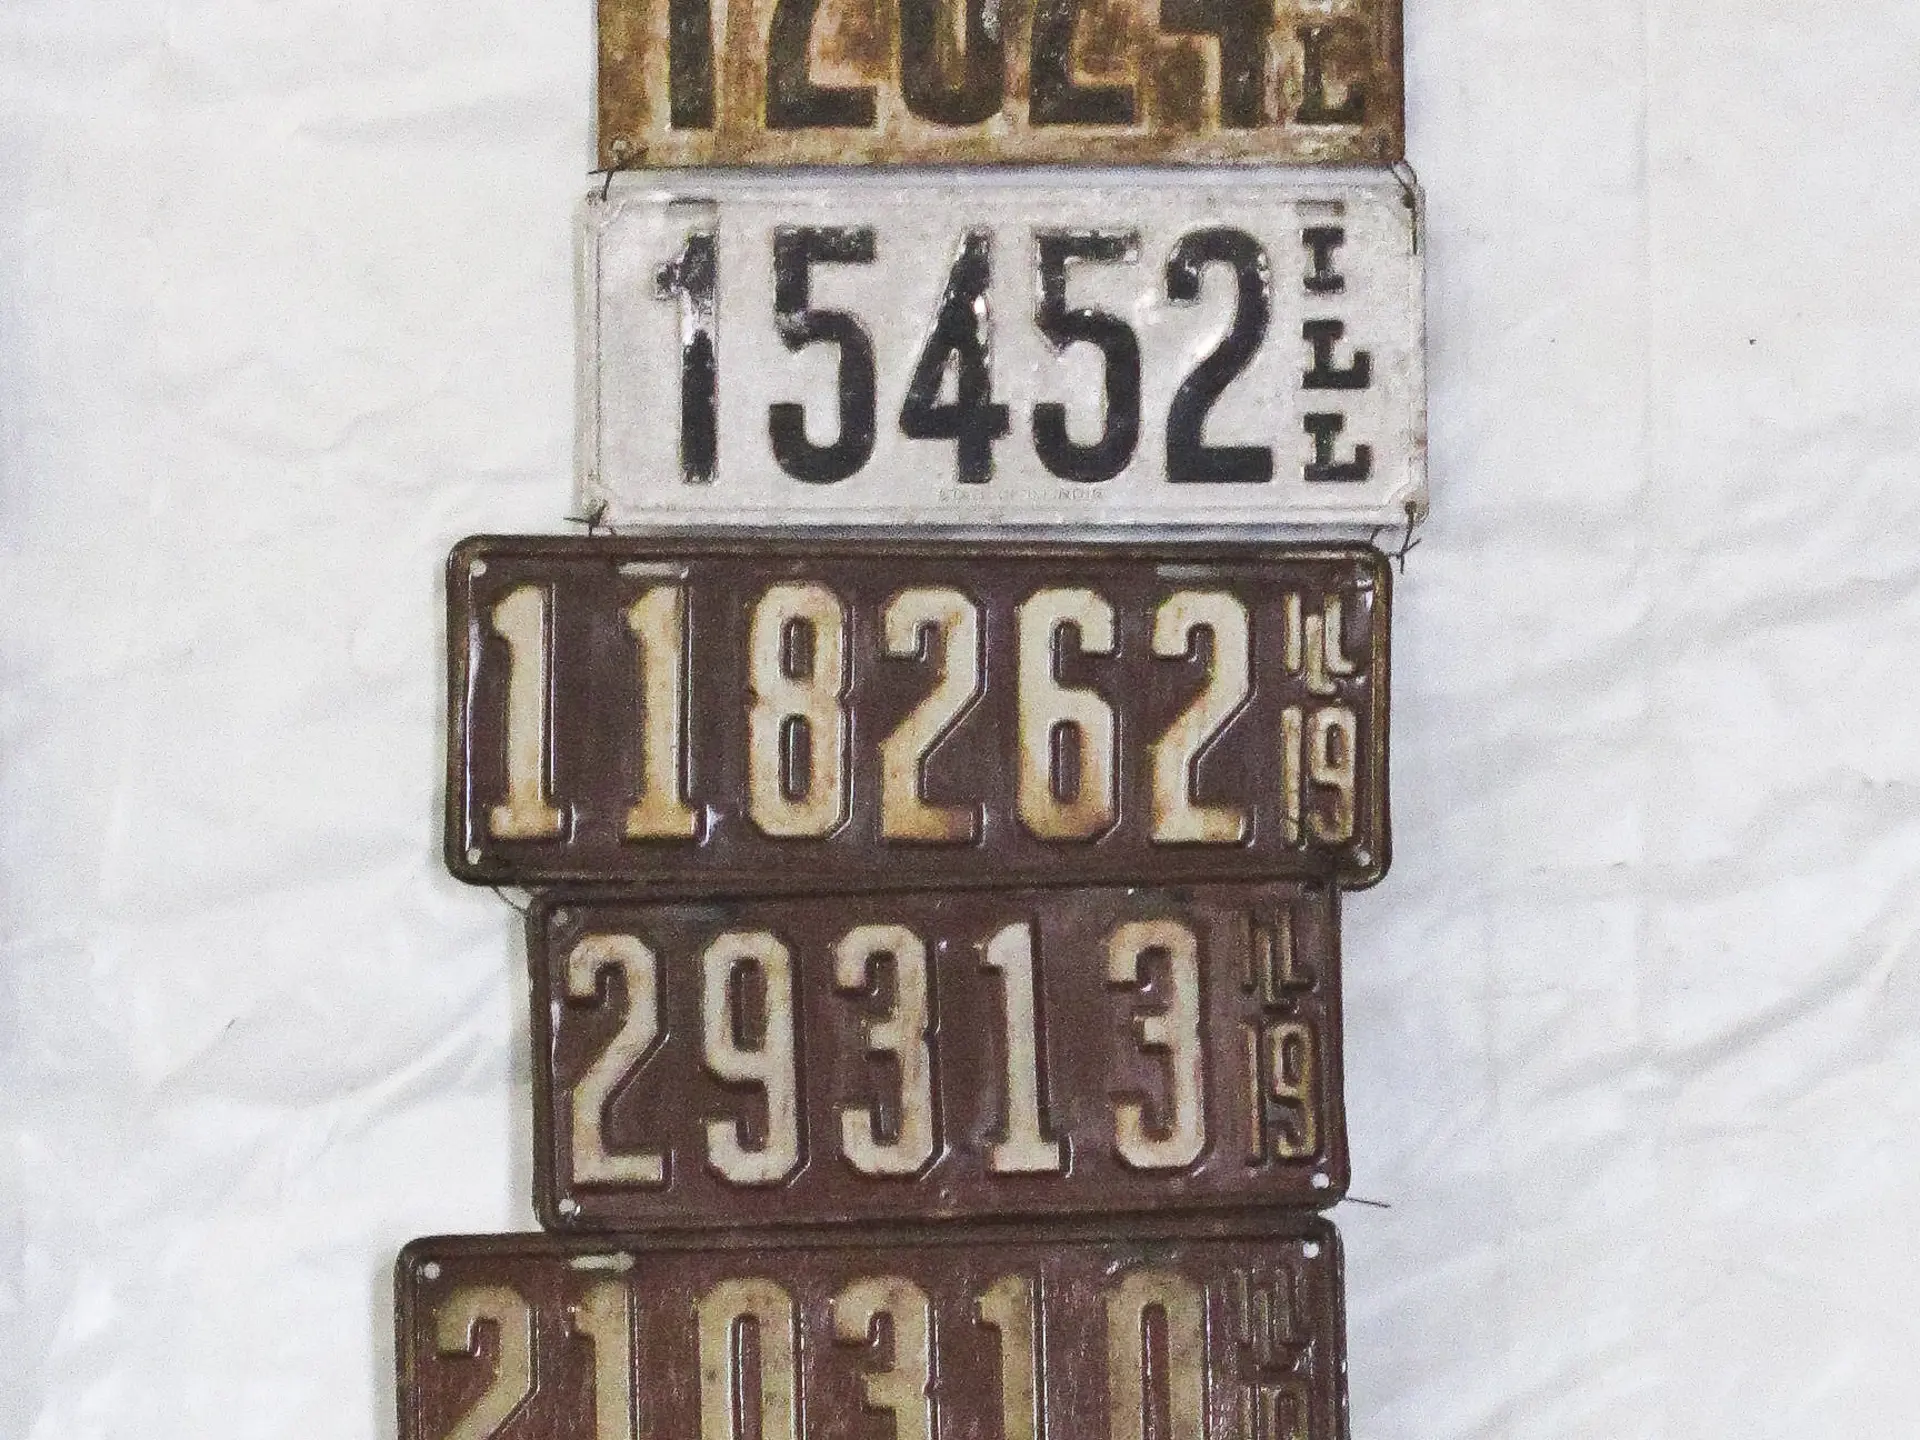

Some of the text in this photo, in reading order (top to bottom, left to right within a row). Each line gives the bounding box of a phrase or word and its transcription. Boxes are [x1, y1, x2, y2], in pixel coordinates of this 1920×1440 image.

[656, 224, 1274, 484] 15452
[1302, 226, 1373, 482] ILL
[488, 582, 1254, 844] 118262
[1283, 590, 1358, 696] ILL
[1280, 704, 1358, 843] 19
[567, 918, 1208, 1188] 29313
[1246, 1020, 1320, 1160] 19
[434, 1266, 1208, 1440] 210310
